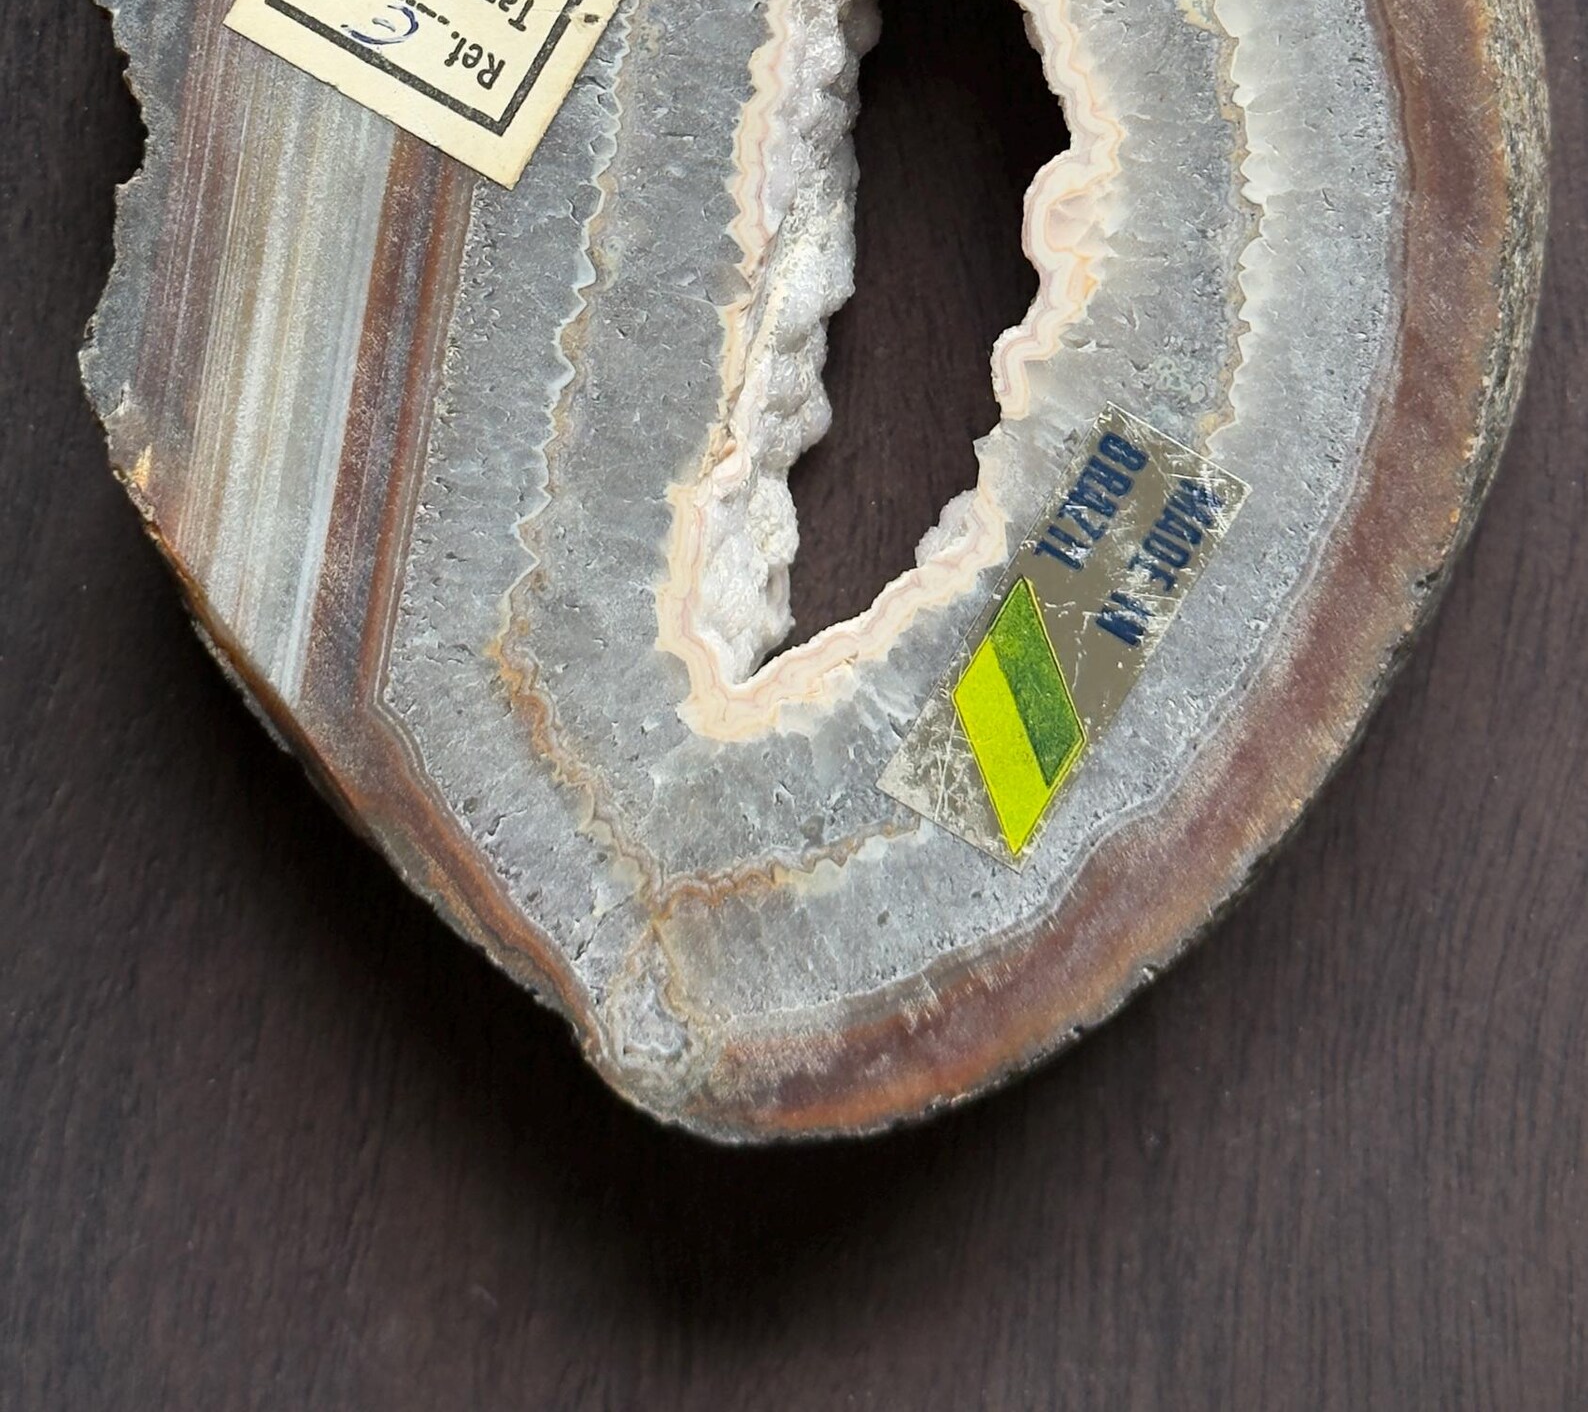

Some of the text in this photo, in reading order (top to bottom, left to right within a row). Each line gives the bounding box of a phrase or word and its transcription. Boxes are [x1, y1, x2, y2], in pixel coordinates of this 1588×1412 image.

[443, 31, 507, 90] Ref.
[1033, 431, 1149, 570] BRAZIL
[1095, 479, 1224, 647] MADE IN
